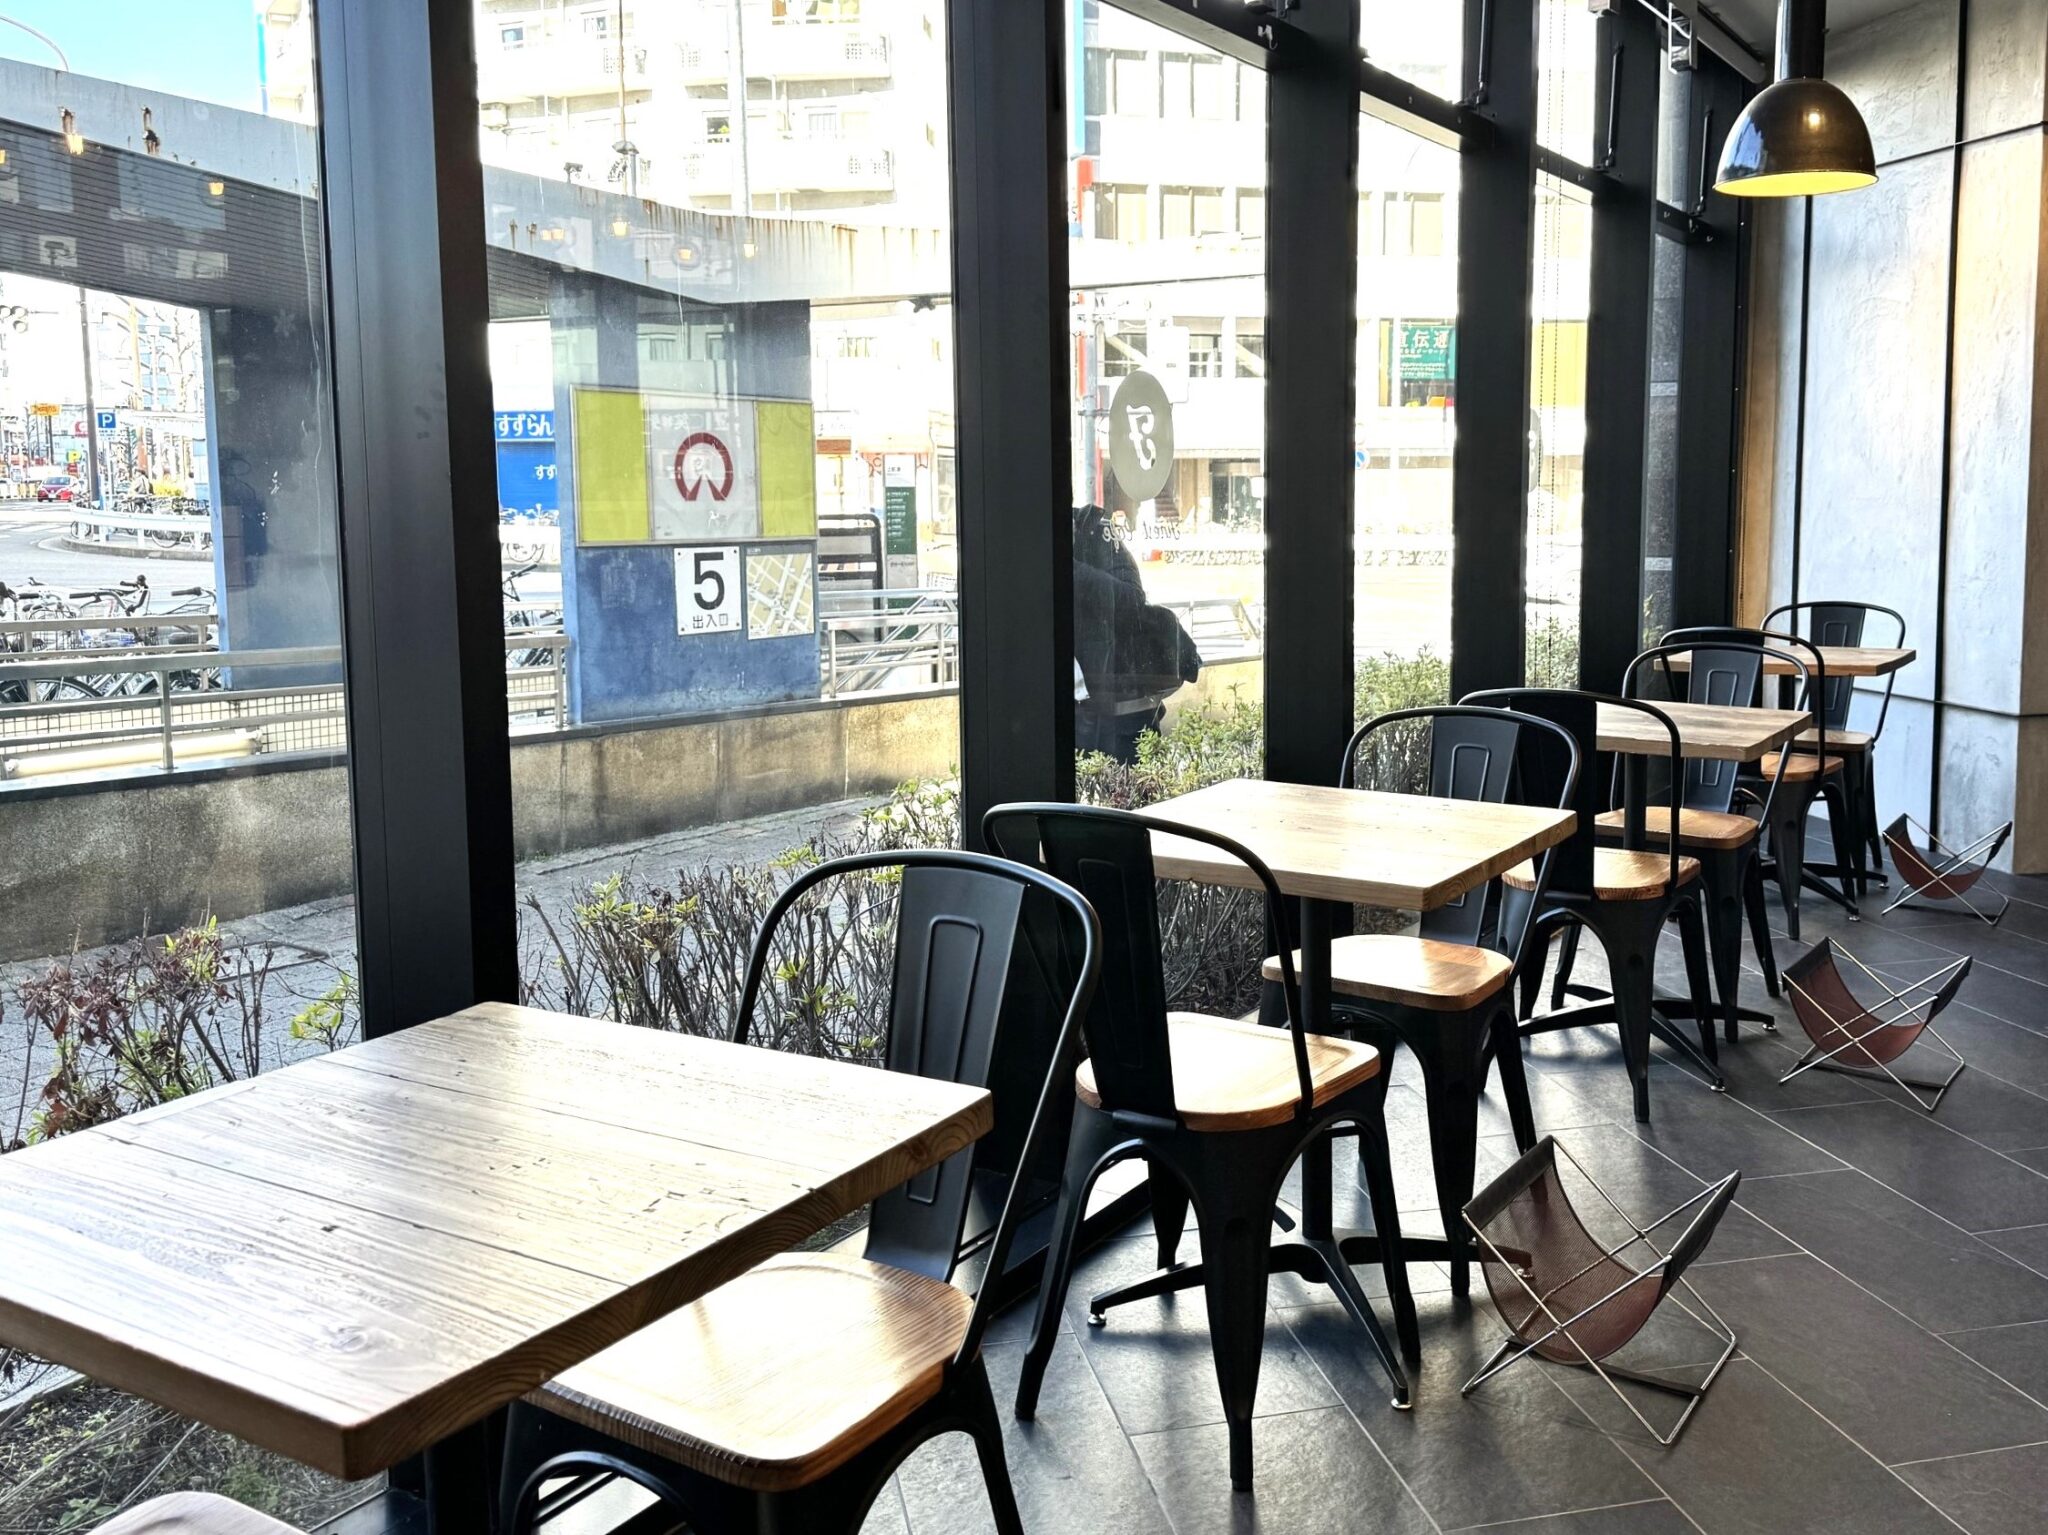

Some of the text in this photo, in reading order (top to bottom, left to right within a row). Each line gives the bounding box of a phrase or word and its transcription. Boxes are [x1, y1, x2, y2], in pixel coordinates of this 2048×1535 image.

[101, 414, 112, 427] P
[496, 413, 555, 437] すずらん
[534, 464, 558, 480] すず
[693, 552, 725, 610] 5
[692, 613, 729, 629] 出入口
